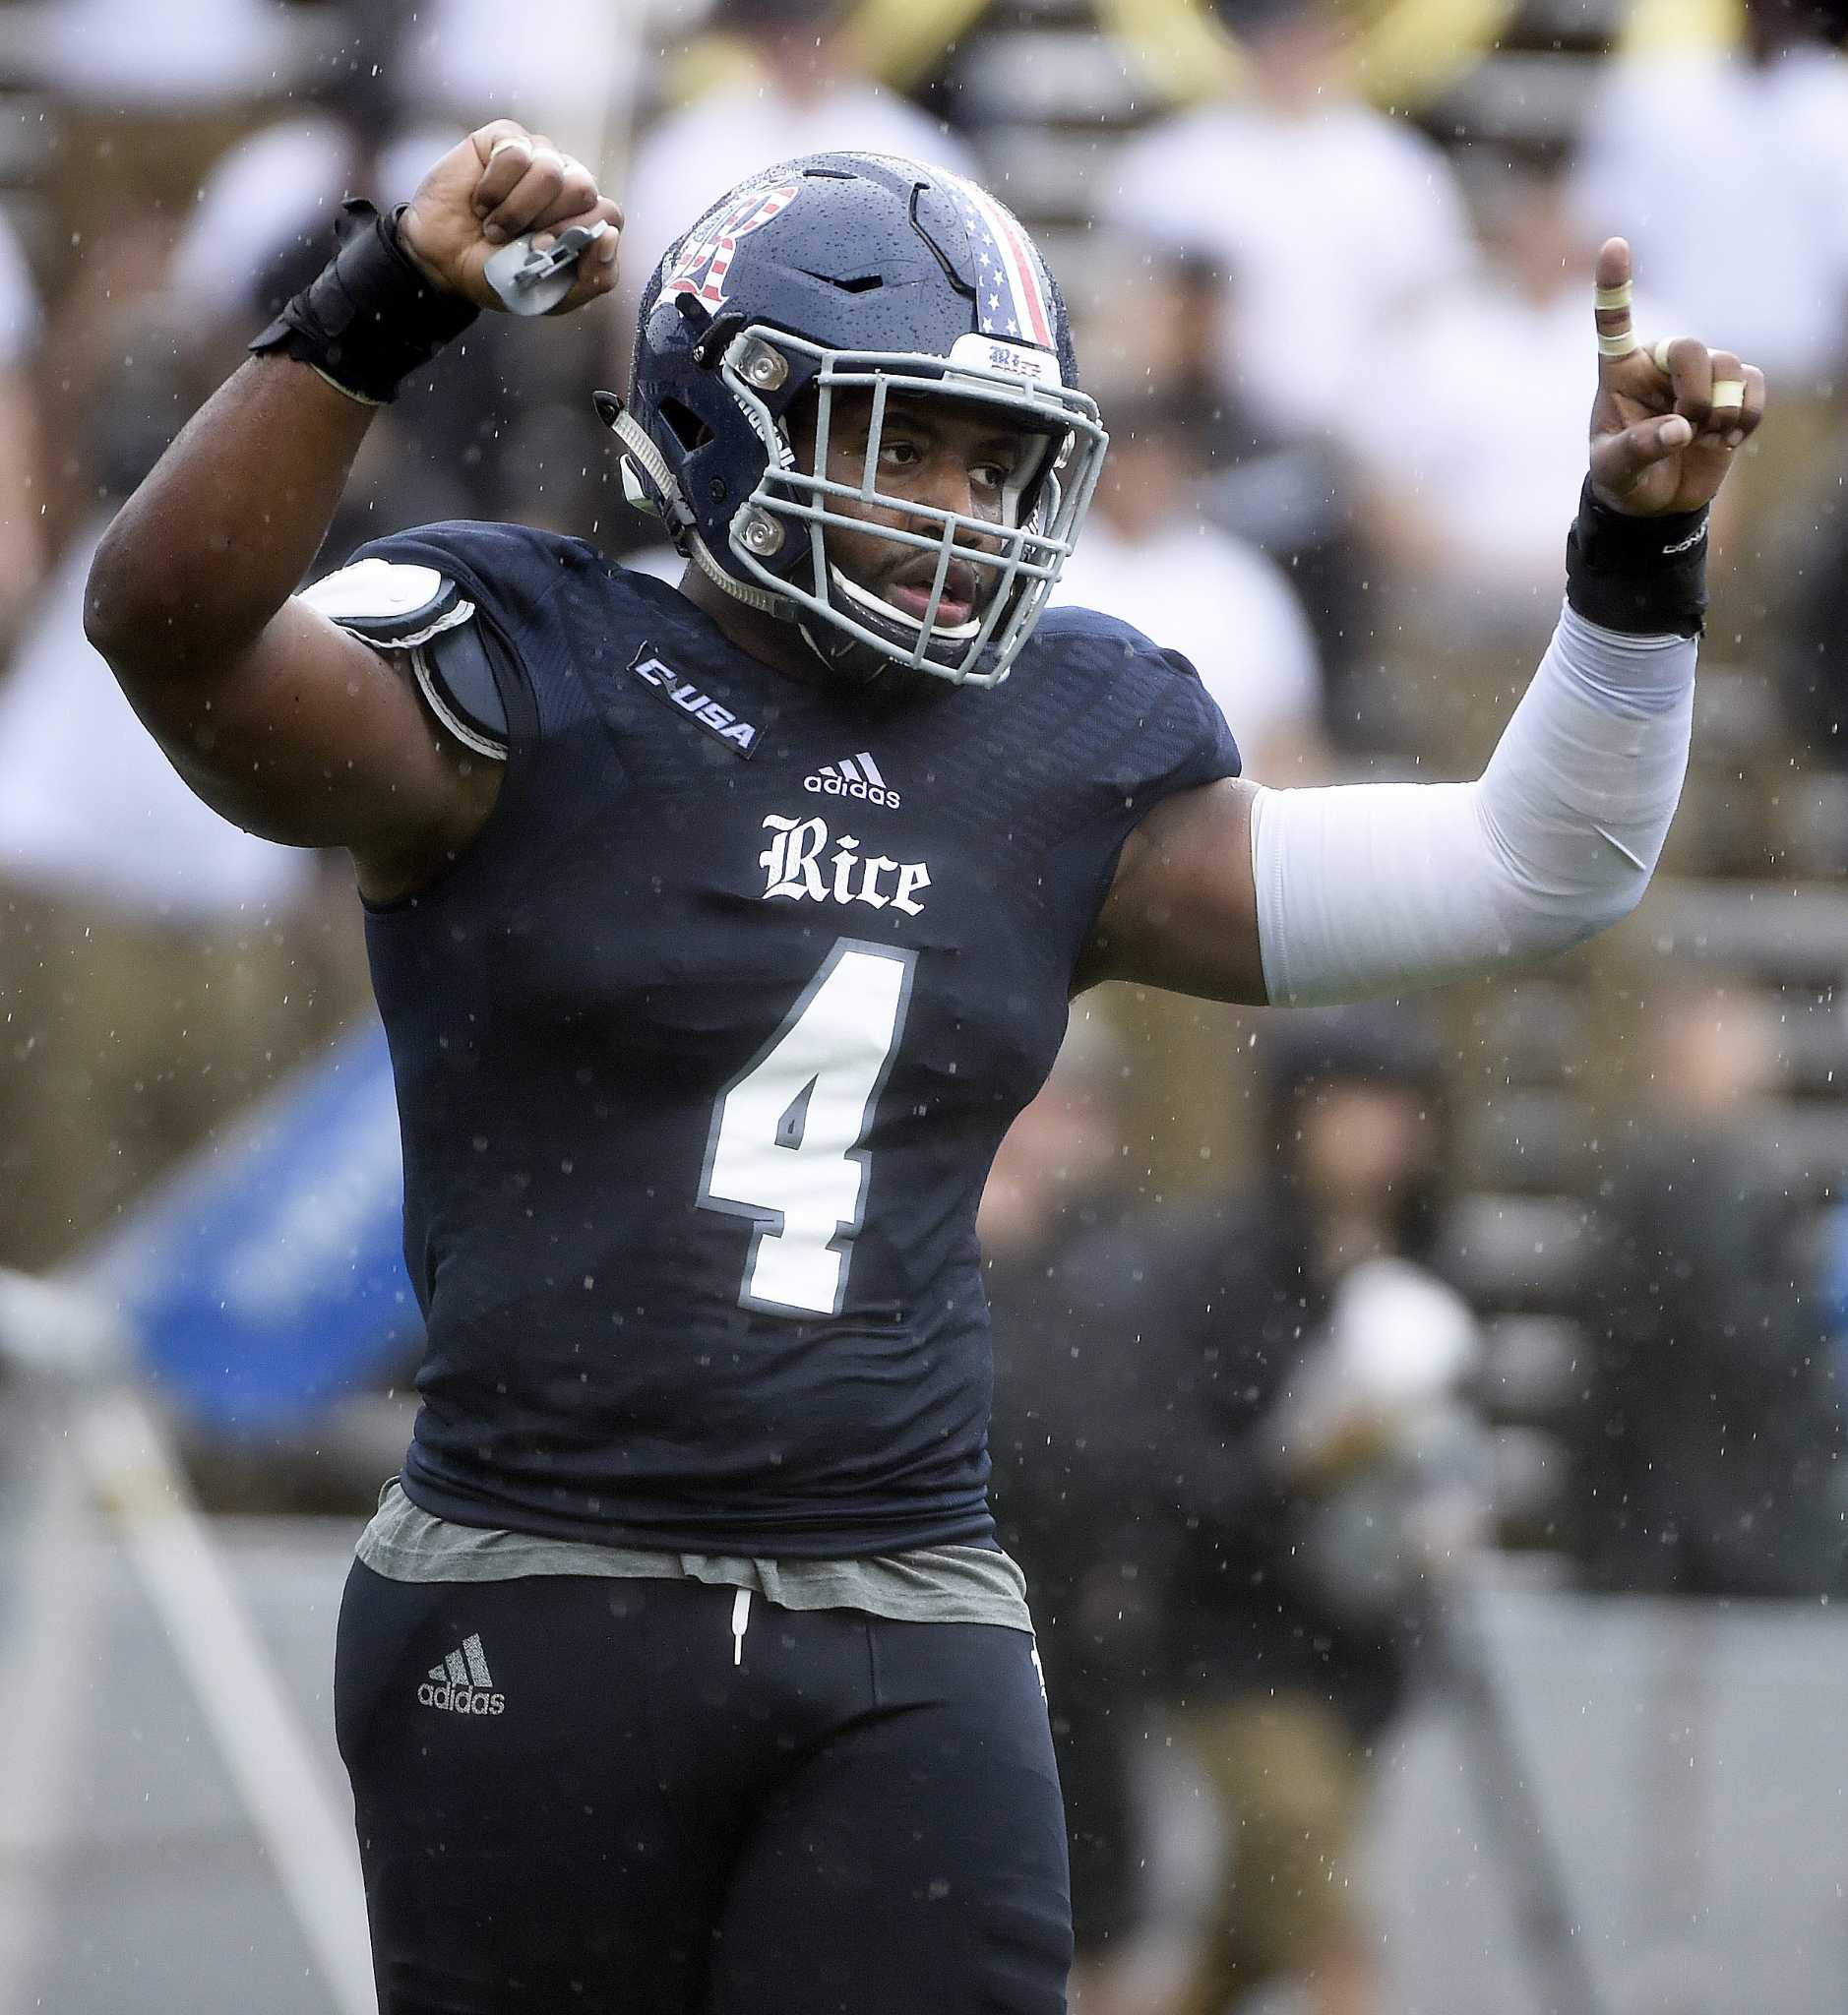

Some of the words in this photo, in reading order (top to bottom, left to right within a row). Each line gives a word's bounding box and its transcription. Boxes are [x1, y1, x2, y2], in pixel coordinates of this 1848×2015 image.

[803, 773, 901, 810] adidas
[759, 814, 932, 916] Rice
[696, 937, 920, 1316] 4
[417, 1681, 505, 1716] adidas
